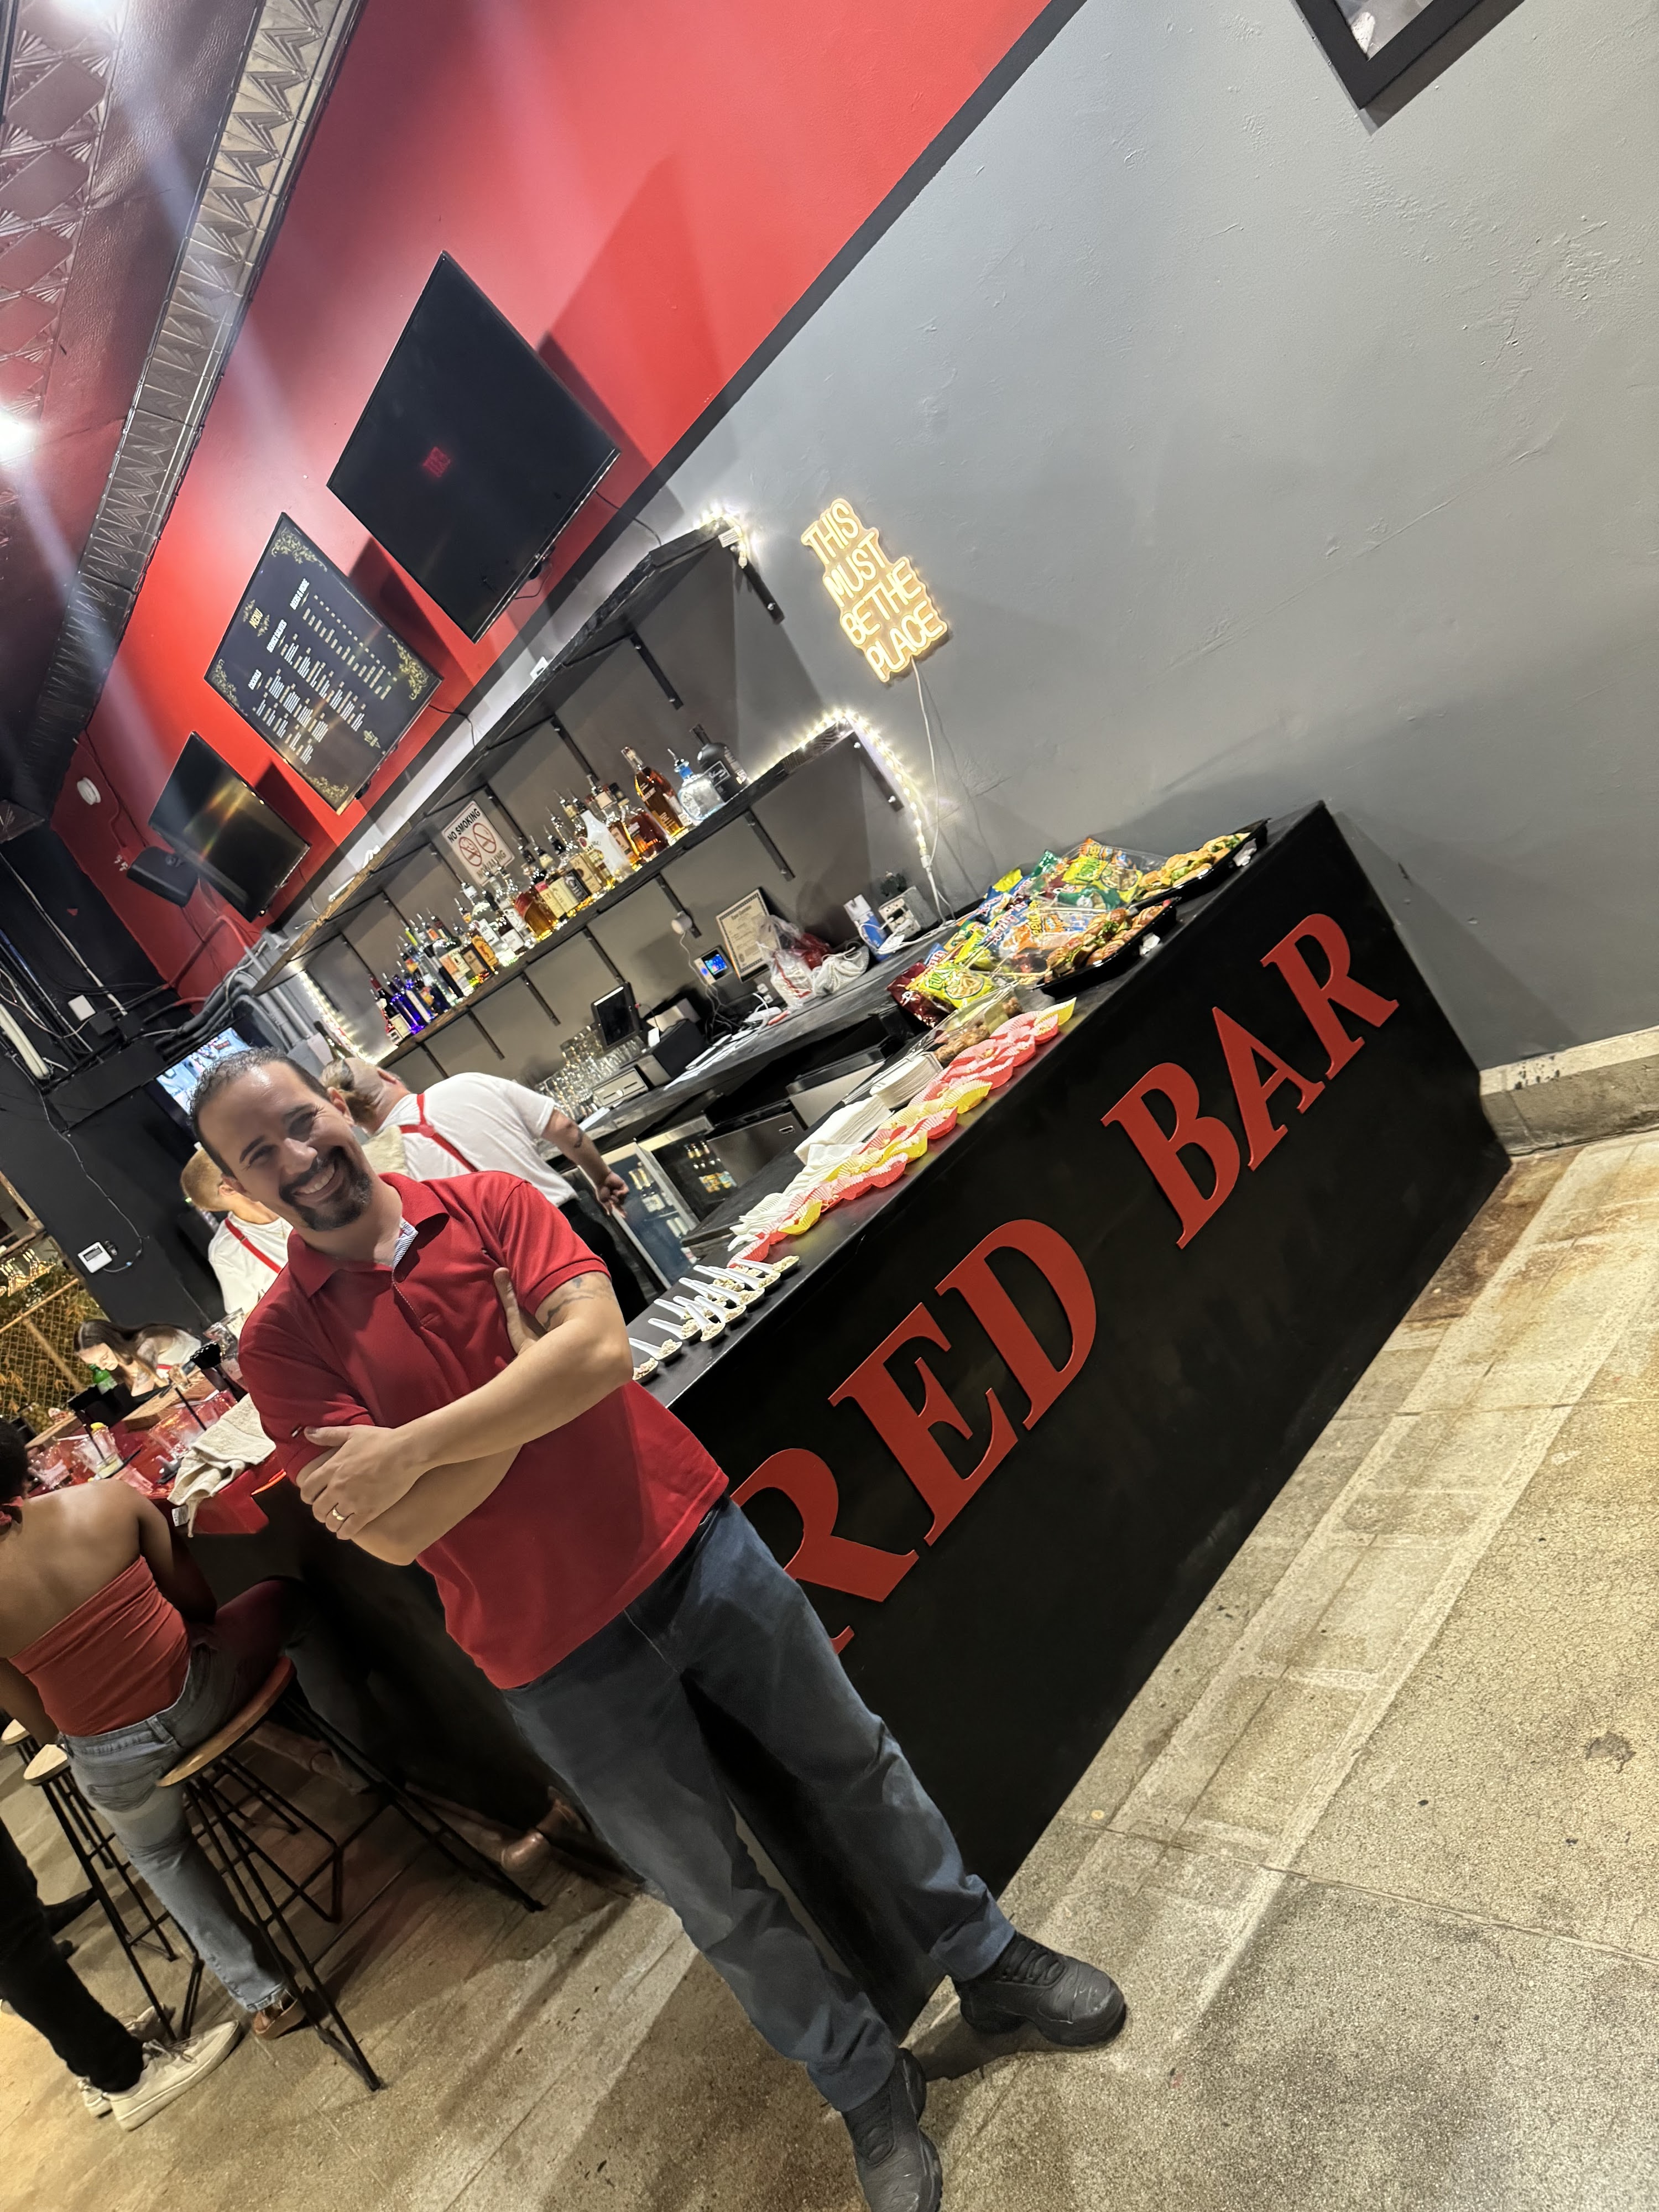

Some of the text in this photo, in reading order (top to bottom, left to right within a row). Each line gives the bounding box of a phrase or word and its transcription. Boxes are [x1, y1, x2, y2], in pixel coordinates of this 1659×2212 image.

[805, 502, 859, 564] THIS
[824, 531, 885, 608] MUST
[249, 608, 263, 629] MENU
[841, 560, 922, 646] BE THE
[865, 600, 943, 680] PLACE
[447, 808, 481, 843] NO SMOKING
[729, 912, 1400, 1654] RED BAR
